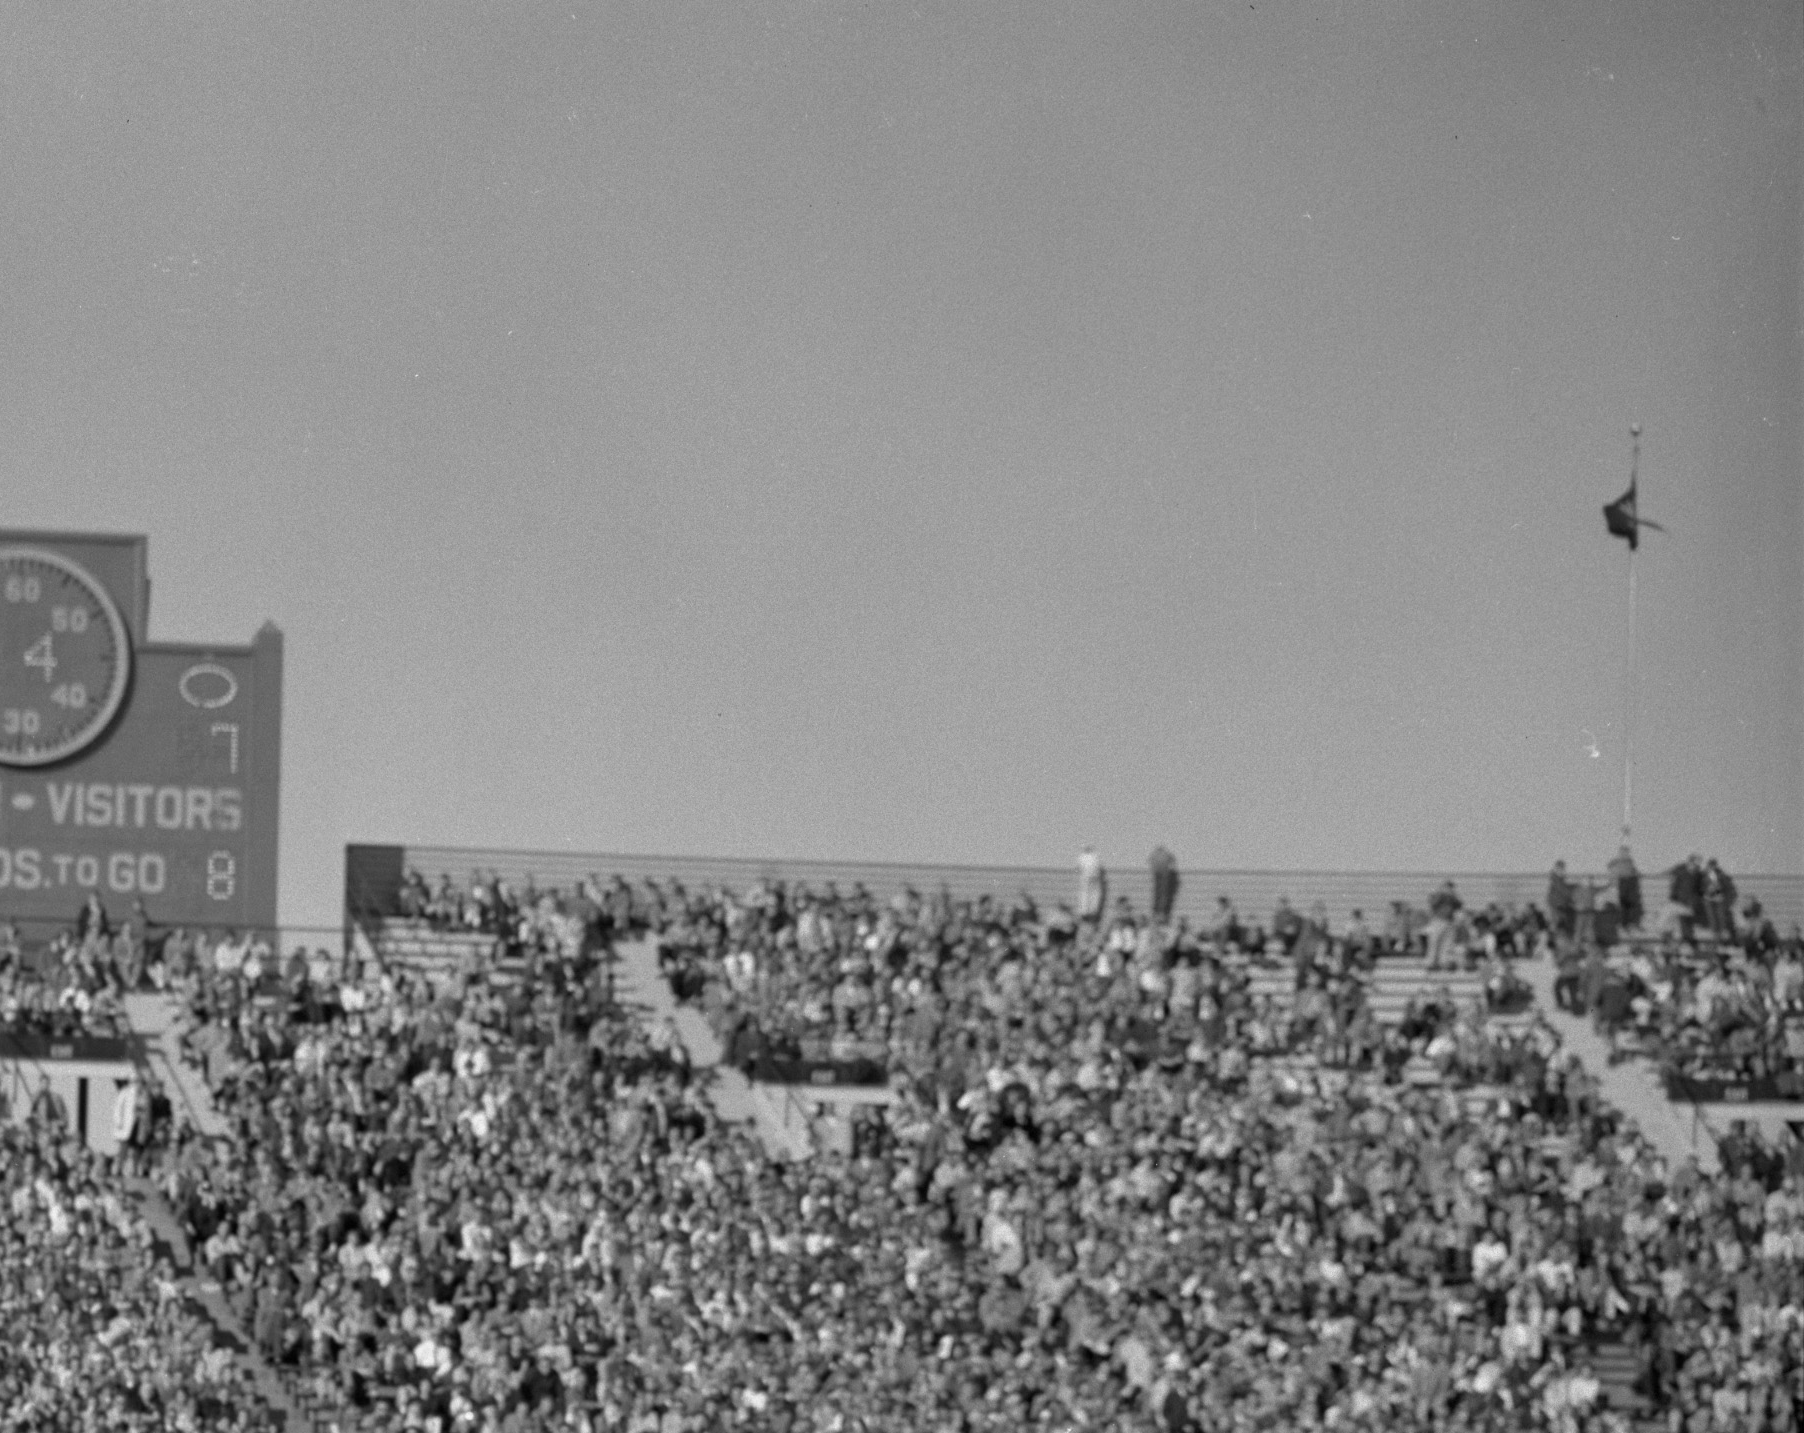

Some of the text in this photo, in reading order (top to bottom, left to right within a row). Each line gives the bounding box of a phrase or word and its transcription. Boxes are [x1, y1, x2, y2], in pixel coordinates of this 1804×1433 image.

[5, 576, 41, 603] 60
[51, 606, 88, 633] 50
[23, 630, 58, 683] 4
[49, 682, 87, 708] 40
[3, 708, 40, 735] 30
[210, 722, 239, 774] 7
[47, 782, 242, 830] VISITORS
[52, 856, 99, 887] TO
[108, 852, 166, 894] GO
[206, 850, 236, 901] 8
